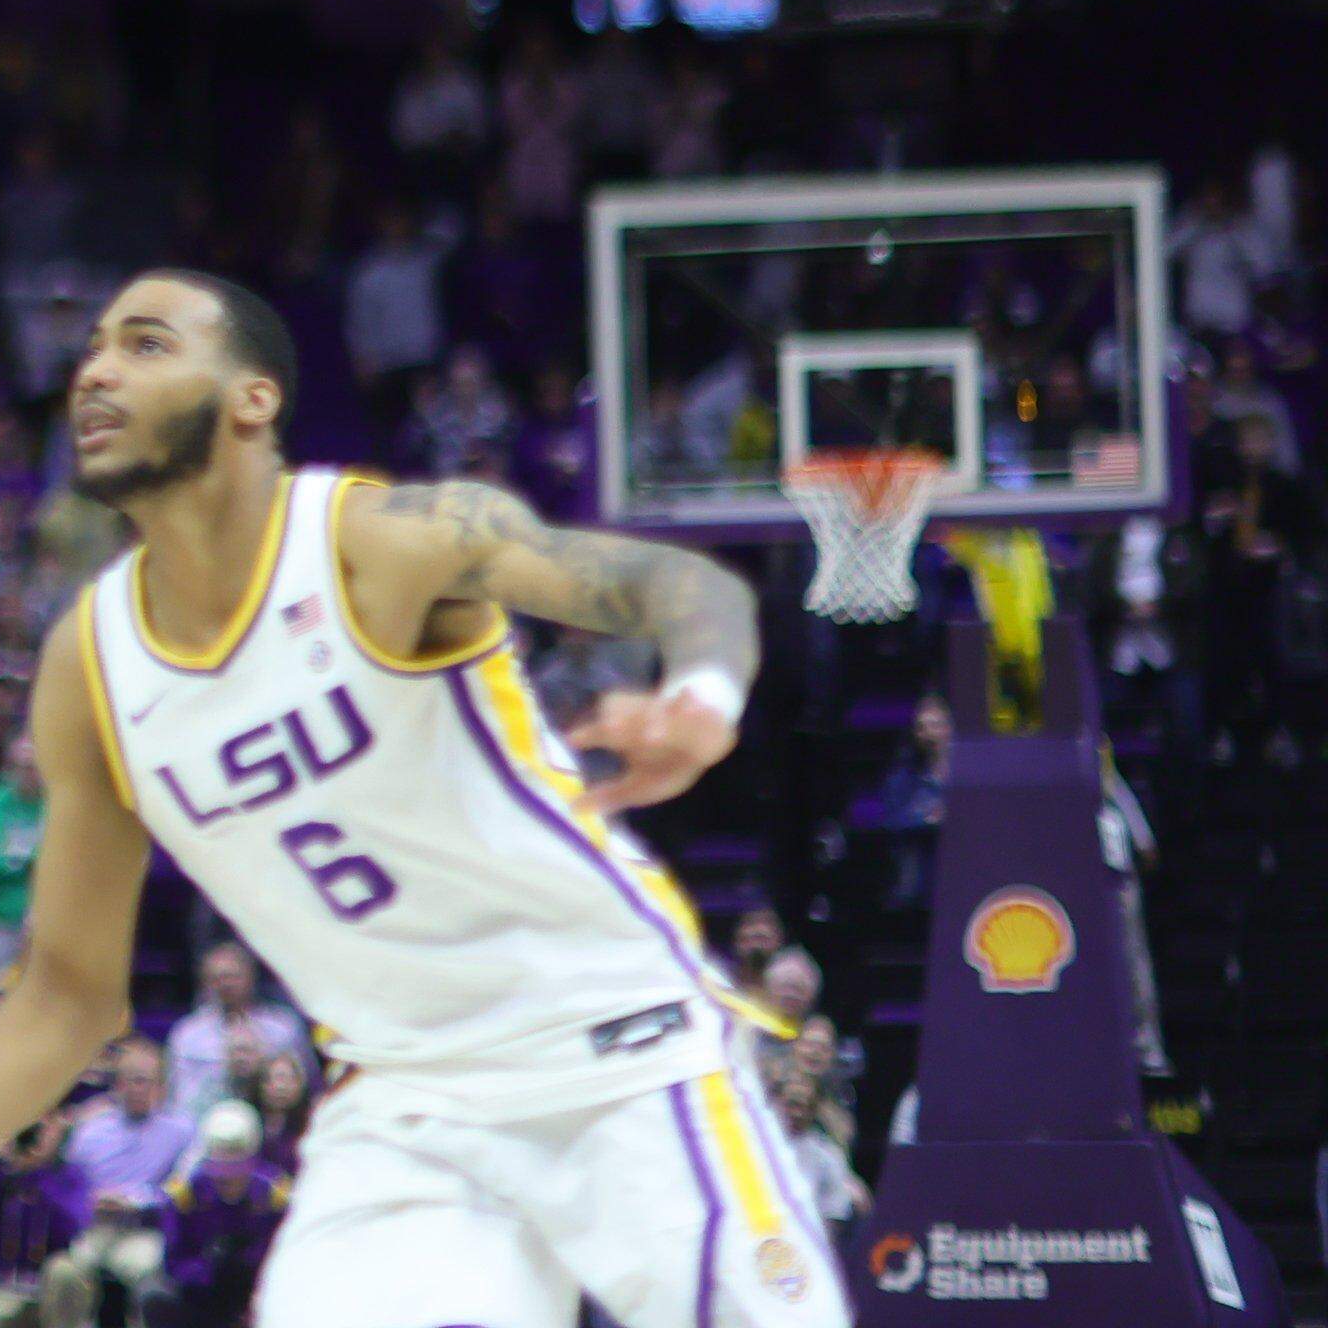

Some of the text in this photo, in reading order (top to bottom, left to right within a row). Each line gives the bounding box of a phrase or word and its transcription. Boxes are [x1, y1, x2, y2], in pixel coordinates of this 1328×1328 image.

[155, 685, 375, 828] LSU
[279, 821, 398, 922] 6
[927, 1223, 1151, 1272] Equipment
[927, 1266, 1049, 1300] Share
